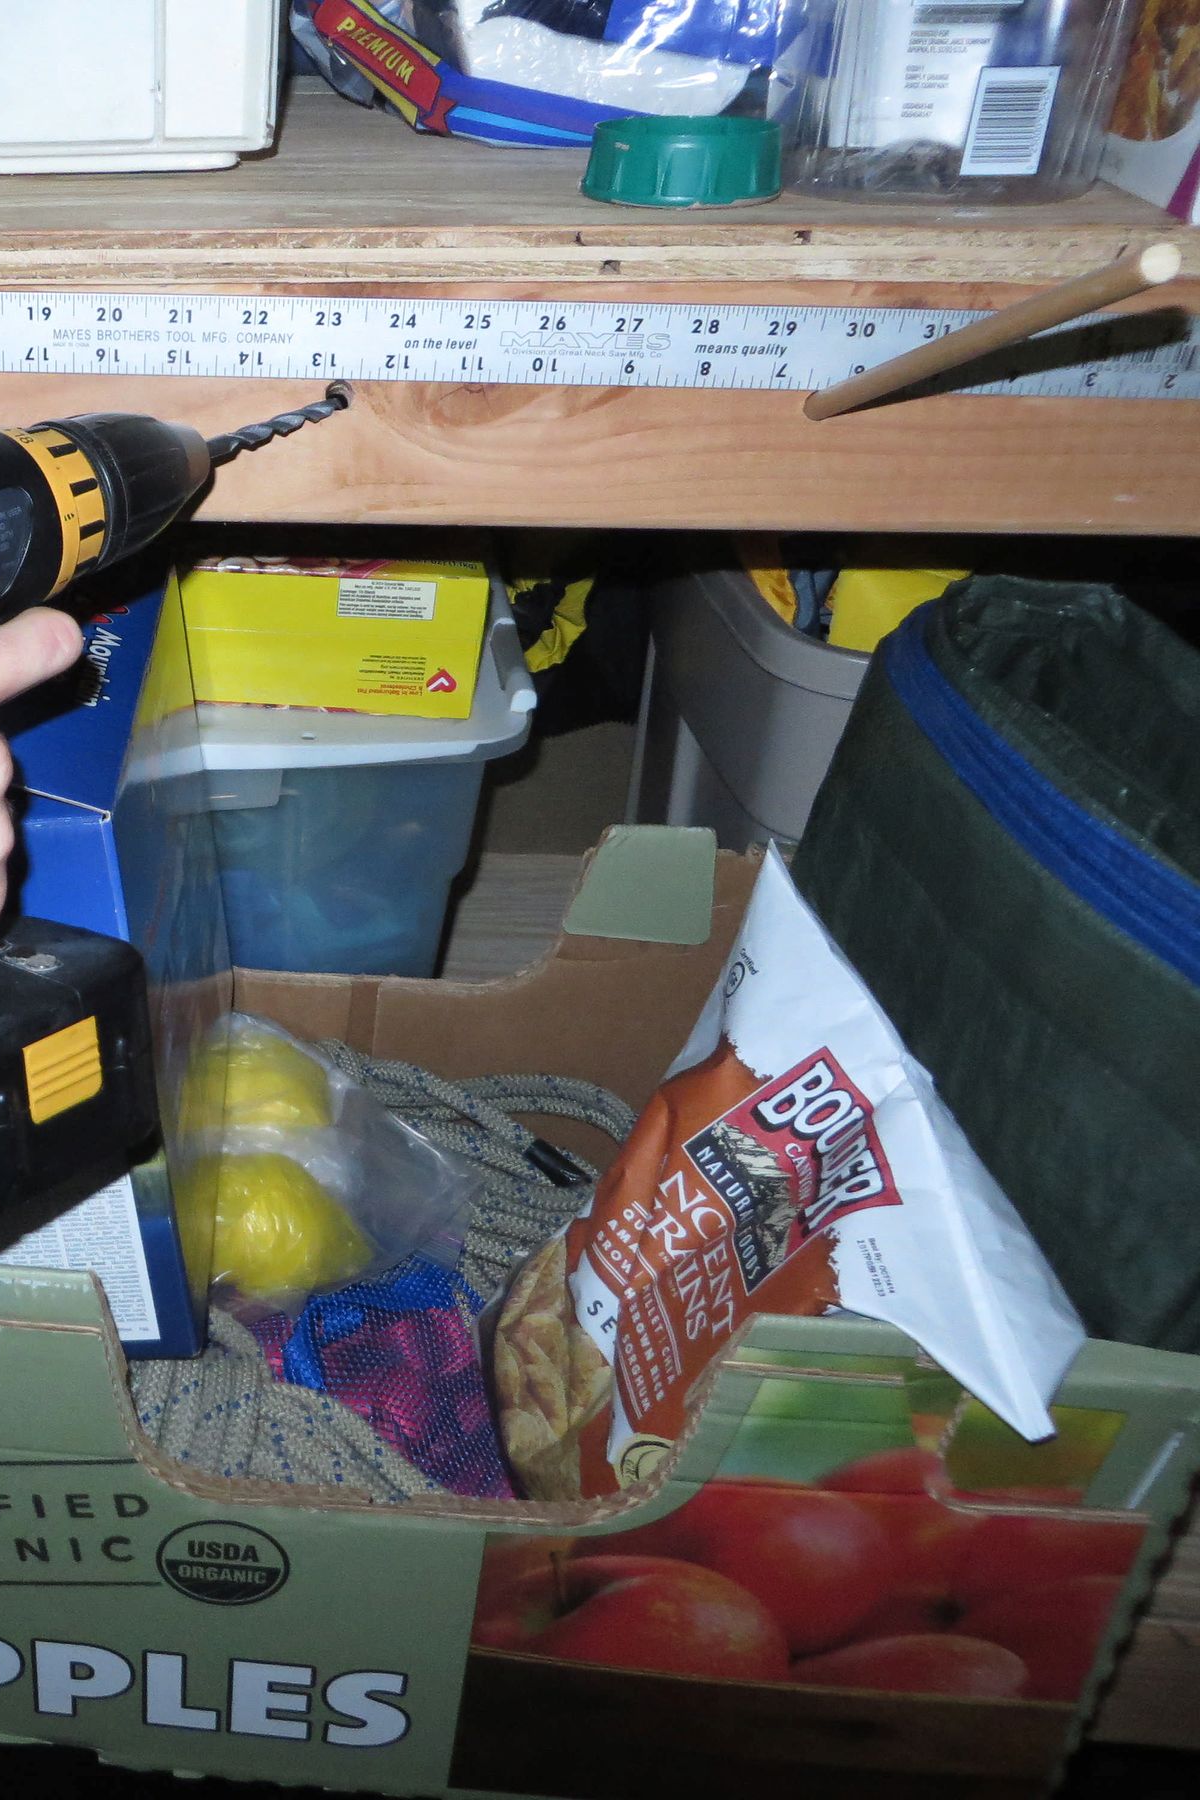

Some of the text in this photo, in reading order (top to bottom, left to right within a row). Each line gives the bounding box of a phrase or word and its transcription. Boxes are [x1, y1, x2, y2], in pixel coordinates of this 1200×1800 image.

[337, 16, 415, 85] PREMIUM
[26, 306, 51, 321] 19
[96, 308, 122, 322] 20
[169, 309, 192, 324] 21
[242, 310, 268, 325] 22
[315, 311, 342, 326] 23
[390, 314, 417, 329] 24
[464, 314, 491, 330] 25
[539, 315, 566, 331] 26
[615, 316, 644, 333] 27
[691, 318, 719, 334] 28
[768, 320, 797, 337] 29
[846, 322, 875, 337] 30
[52, 328, 295, 345] MAYES BROTHERS TOOL MFG. COMPANY
[404, 338, 478, 350] on the level
[499, 330, 672, 351] MAYES
[609, 350, 627, 358] Saw
[694, 341, 788, 358] means quality
[25, 347, 49, 361] 17
[96, 348, 120, 363] 16
[167, 349, 191, 364] 15
[239, 351, 264, 366] 14
[312, 352, 337, 367] 13
[385, 354, 410, 369] 12
[461, 356, 484, 371] 11
[532, 356, 558, 372] 10
[624, 358, 635, 374] 9
[699, 361, 711, 376] 8
[775, 362, 788, 378] 7
[1085, 372, 1096, 387] 3
[1164, 373, 1178, 389] 2
[785, 1142, 813, 1201] CANYON
[738, 1225, 761, 1280] FOODS
[647, 1203, 707, 1340] RAINS
[629, 1302, 655, 1361] BROWN
[650, 1364, 665, 1401] RICE
[661, 1346, 677, 1385] CHIA
[622, 1334, 653, 1412] SORGHUM
[186, 1542, 260, 1565] USDA
[177, 1563, 268, 1585] ORGANIC
